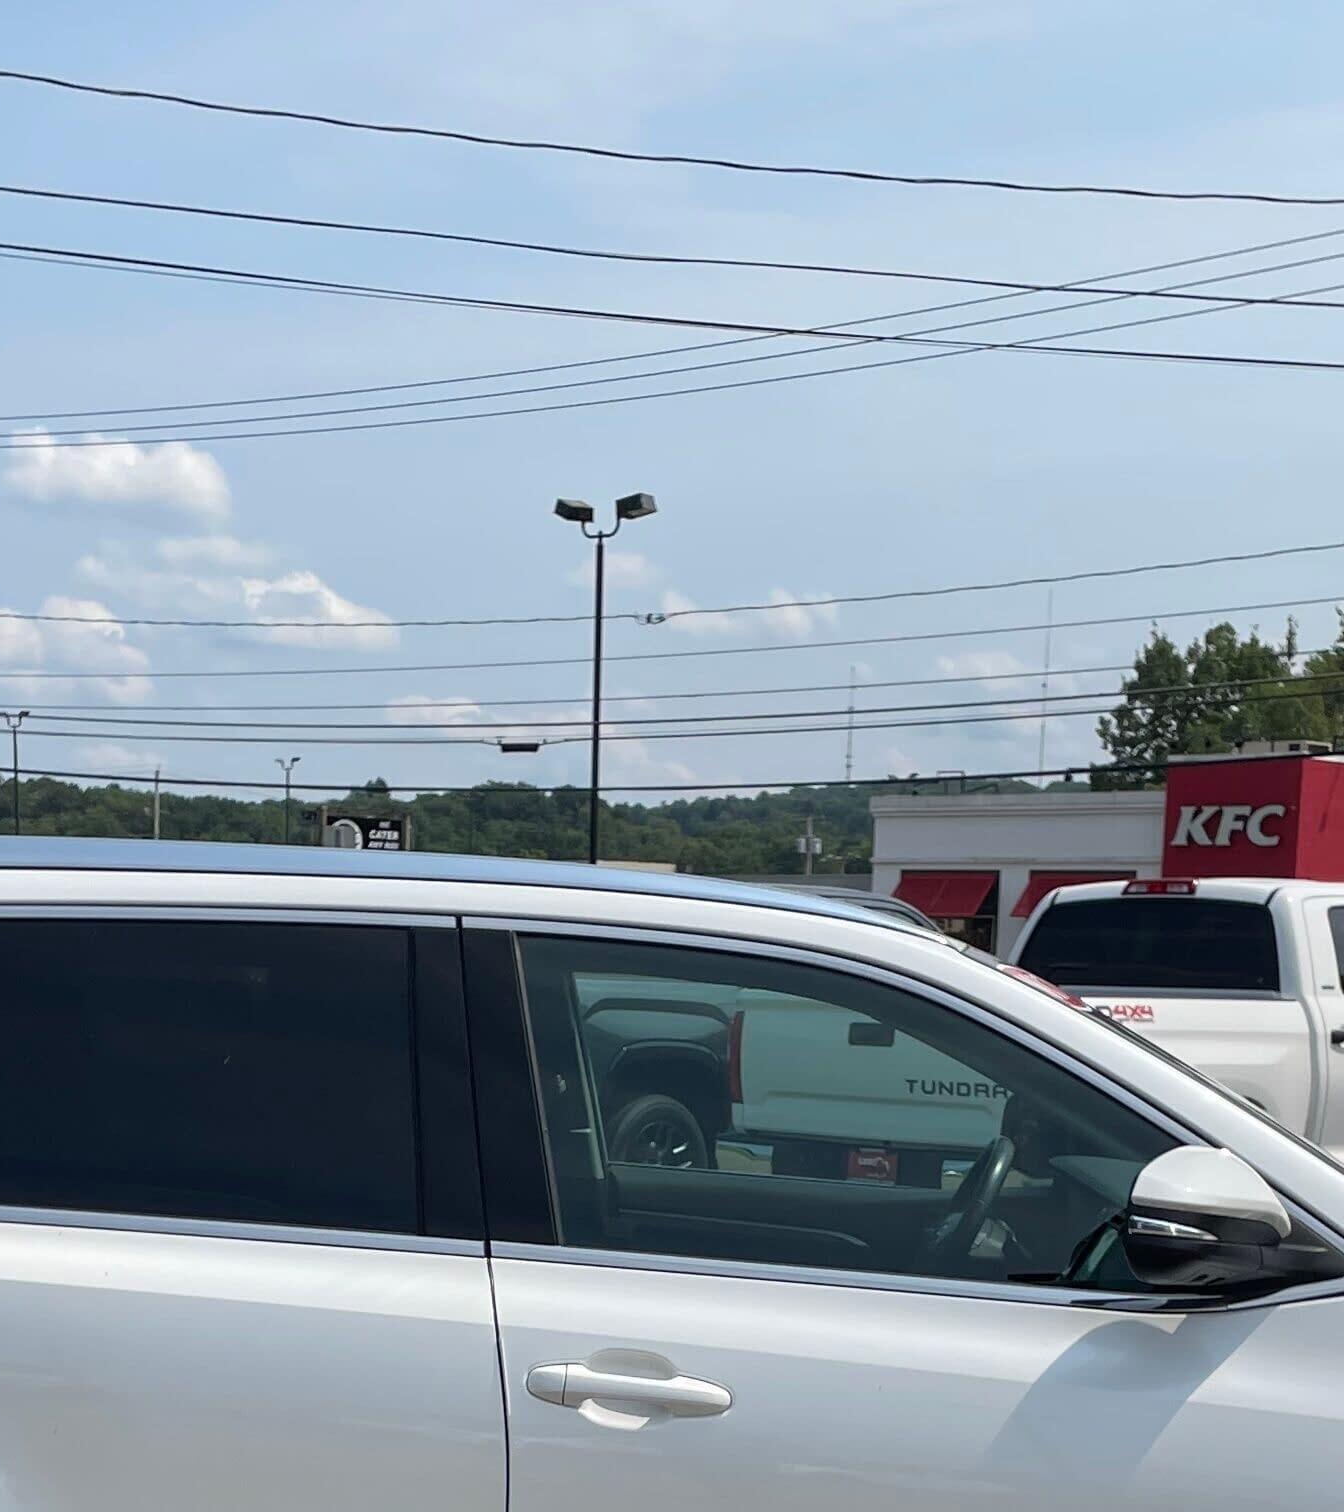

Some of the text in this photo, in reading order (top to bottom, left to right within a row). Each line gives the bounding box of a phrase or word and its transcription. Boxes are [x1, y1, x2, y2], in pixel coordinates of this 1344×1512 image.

[1170, 804, 1286, 847] KFC
[1114, 1004, 1154, 1018] 4X4
[904, 1079, 1008, 1099] TUNDRA
